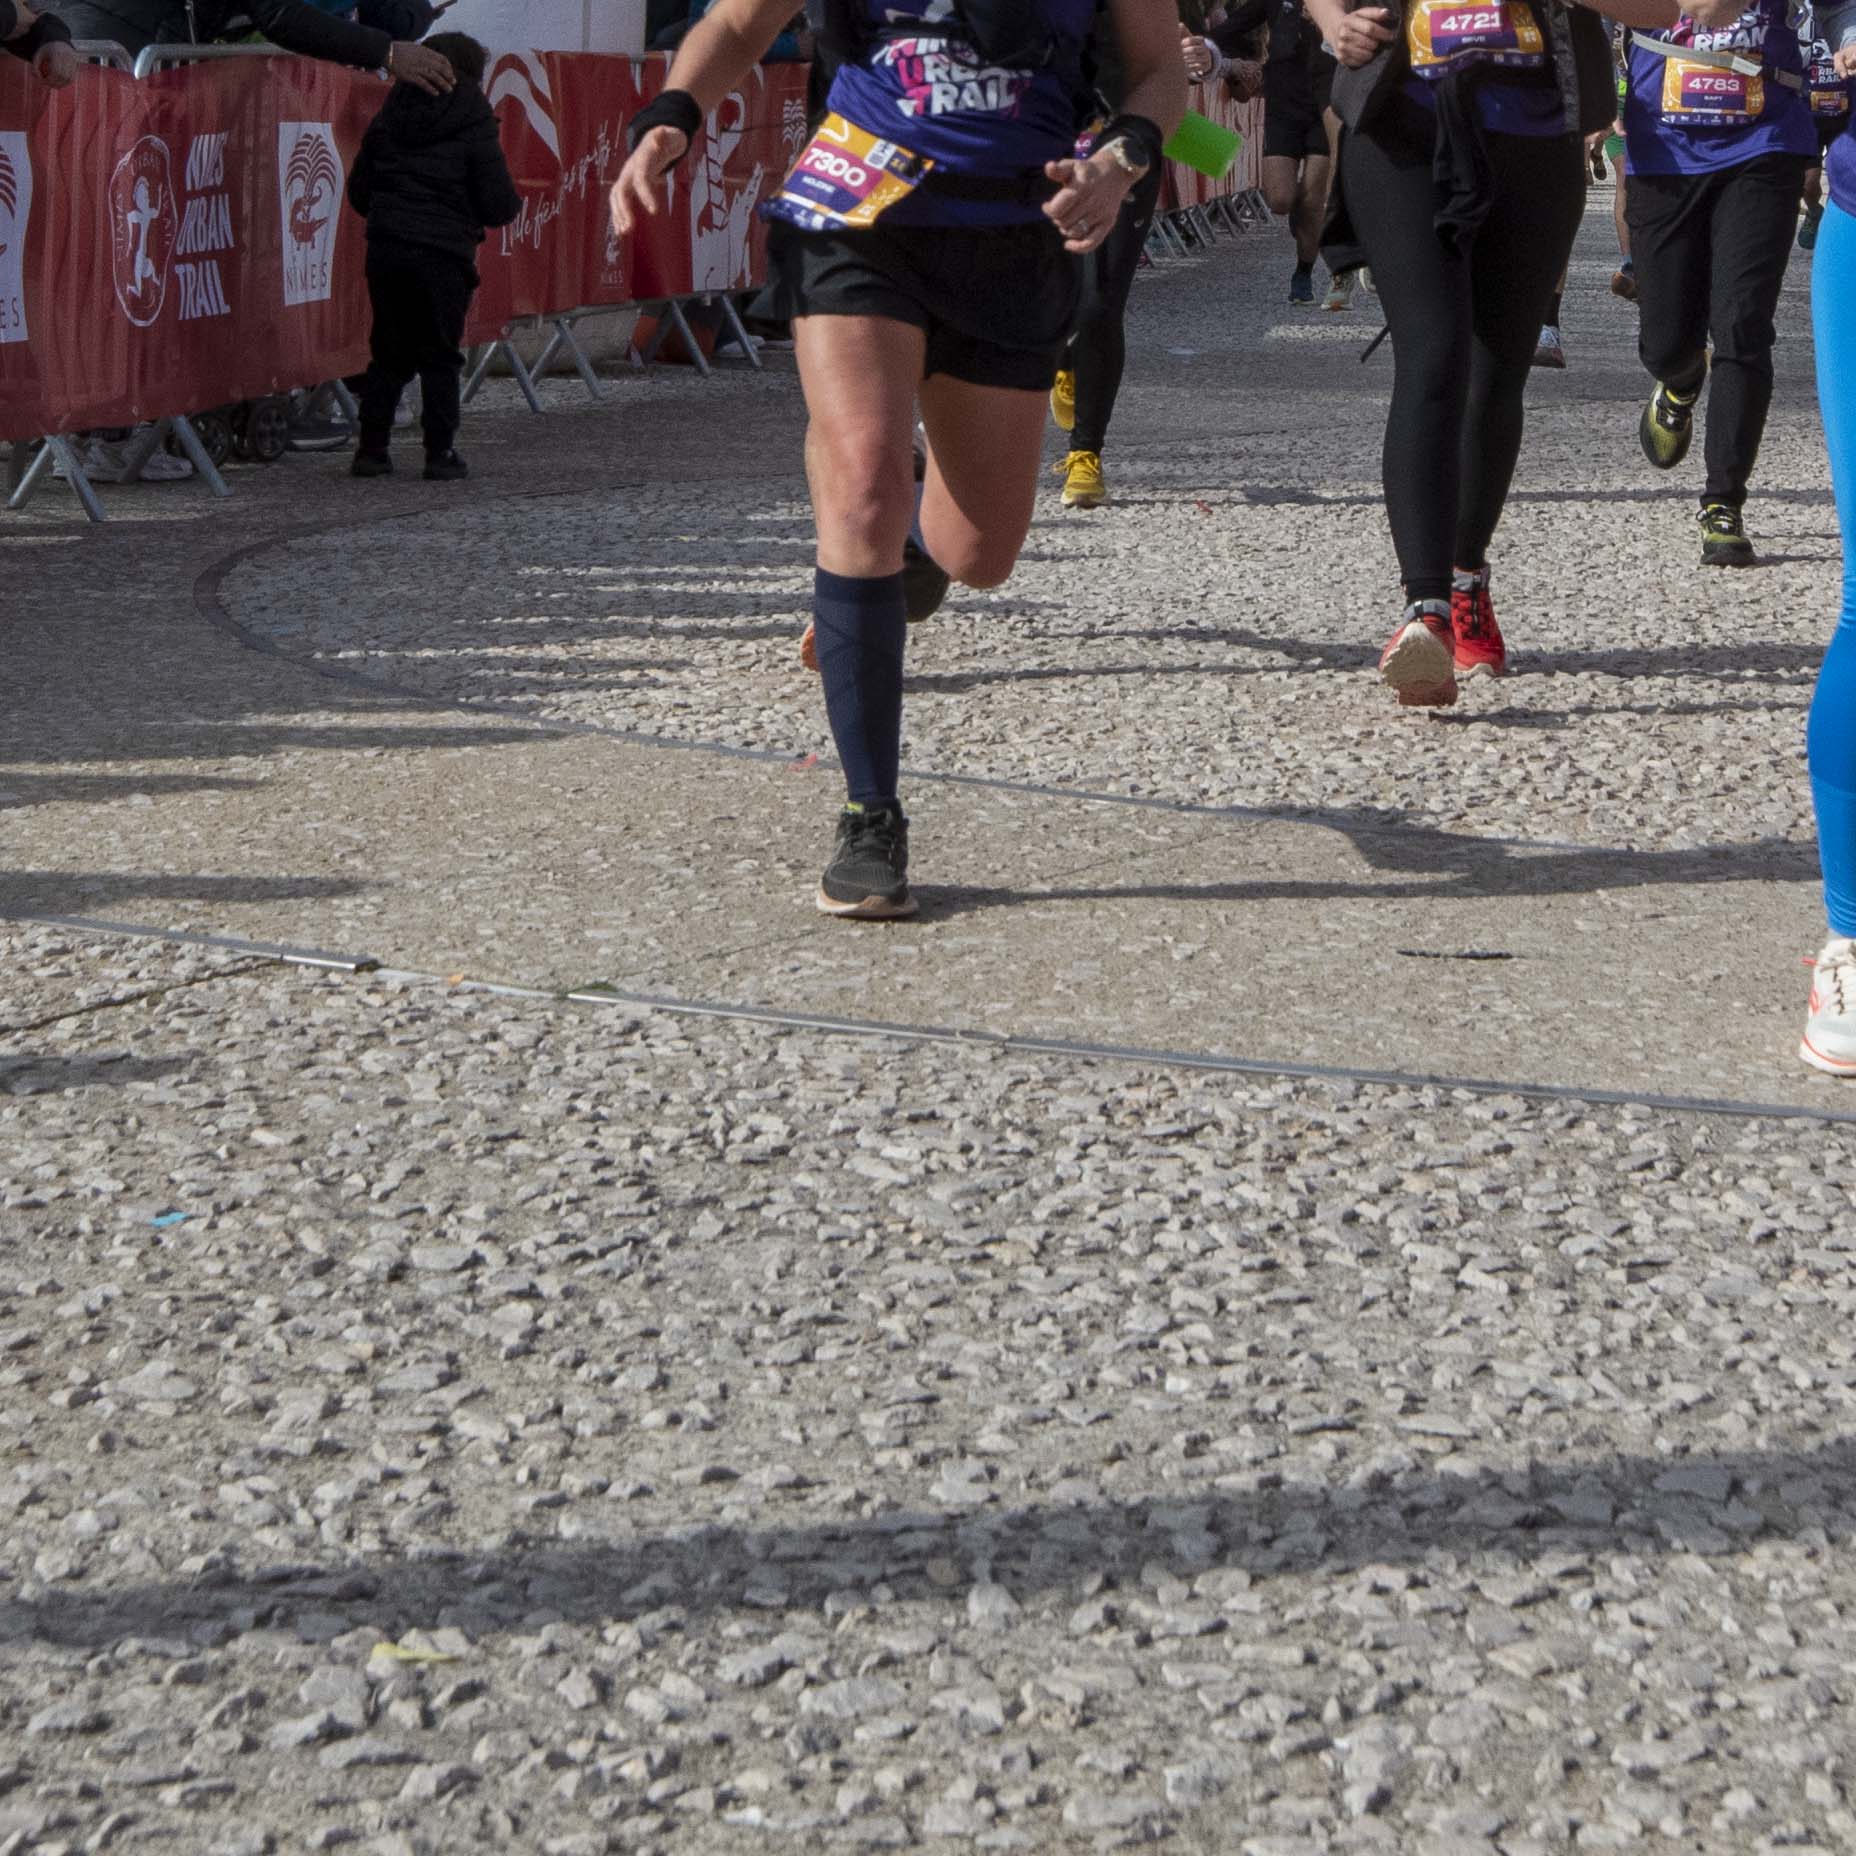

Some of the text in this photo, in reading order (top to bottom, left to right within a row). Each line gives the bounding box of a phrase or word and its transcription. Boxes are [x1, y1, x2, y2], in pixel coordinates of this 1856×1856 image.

[1440, 11, 1501, 30] 4721
[904, 81, 1018, 117] TRAIL
[1688, 77, 1740, 92] 4783
[803, 147, 867, 187] 7300
[174, 259, 231, 321] TRAIL
